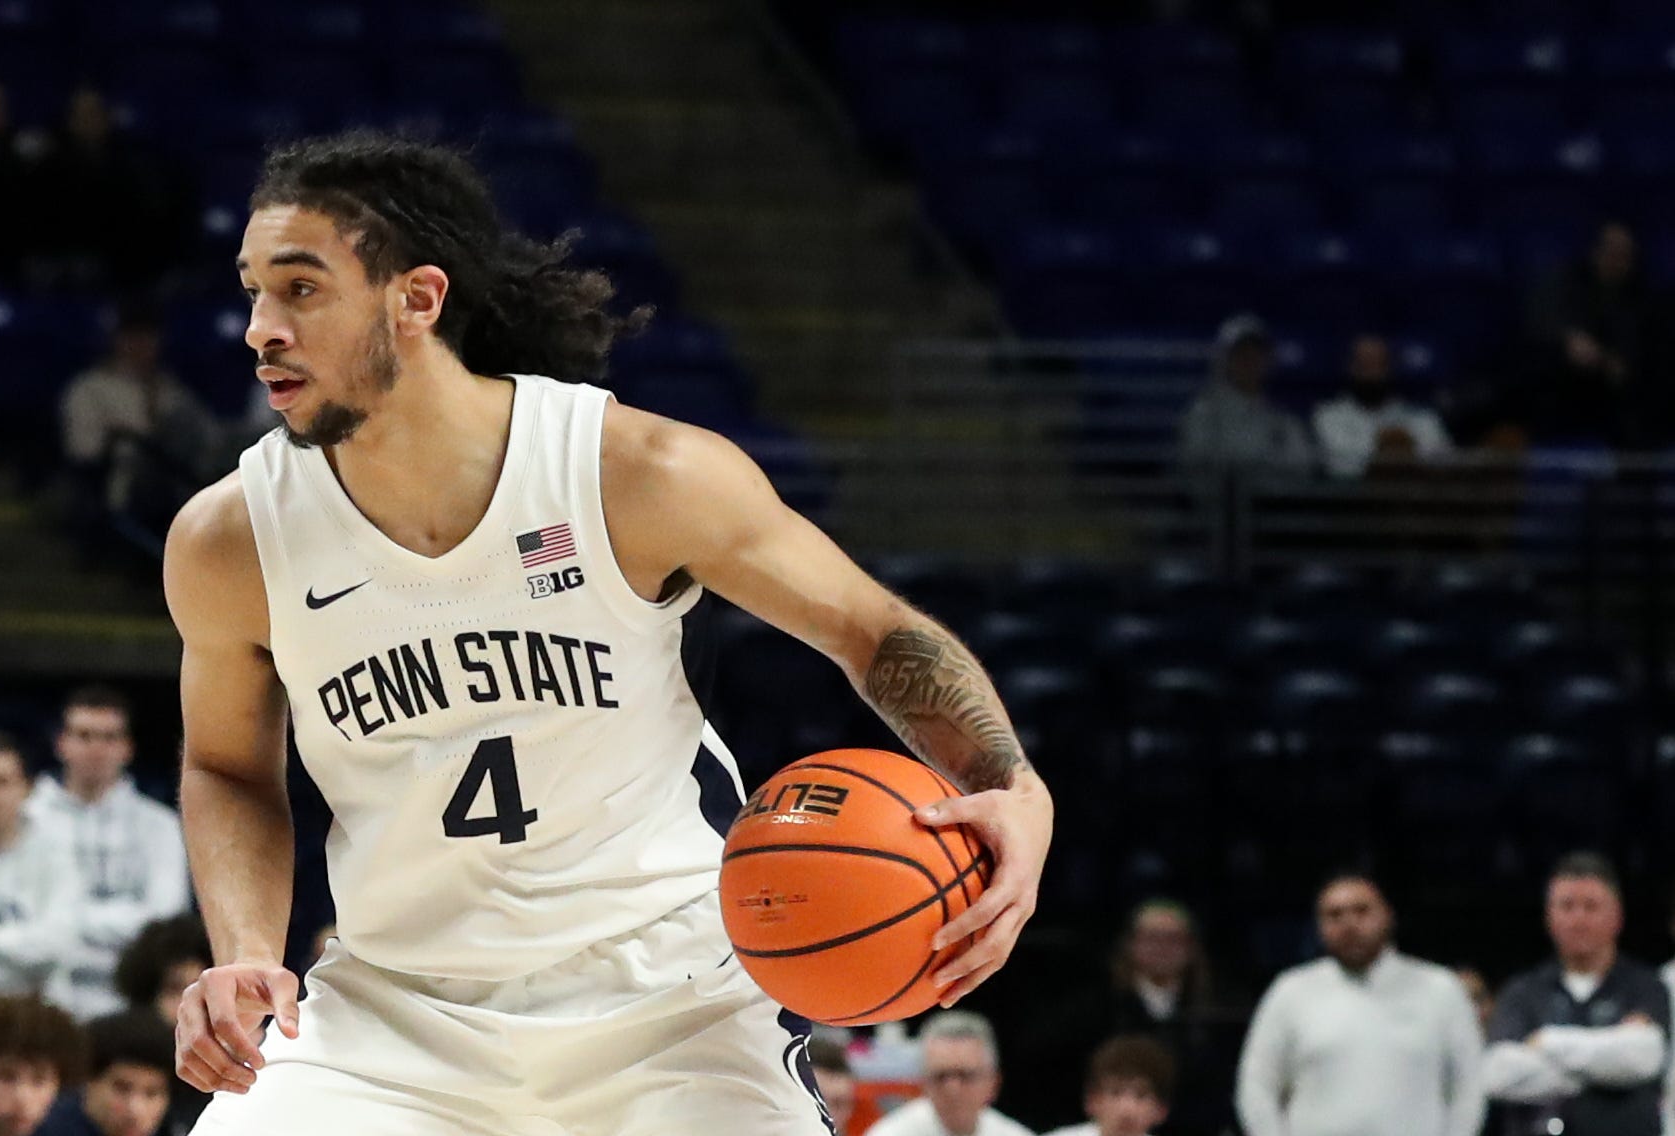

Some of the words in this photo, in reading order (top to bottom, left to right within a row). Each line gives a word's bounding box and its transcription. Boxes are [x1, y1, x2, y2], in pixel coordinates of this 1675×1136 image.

[317, 638, 450, 742] PENN
[454, 630, 620, 710] STATE
[442, 735, 538, 845] 4
